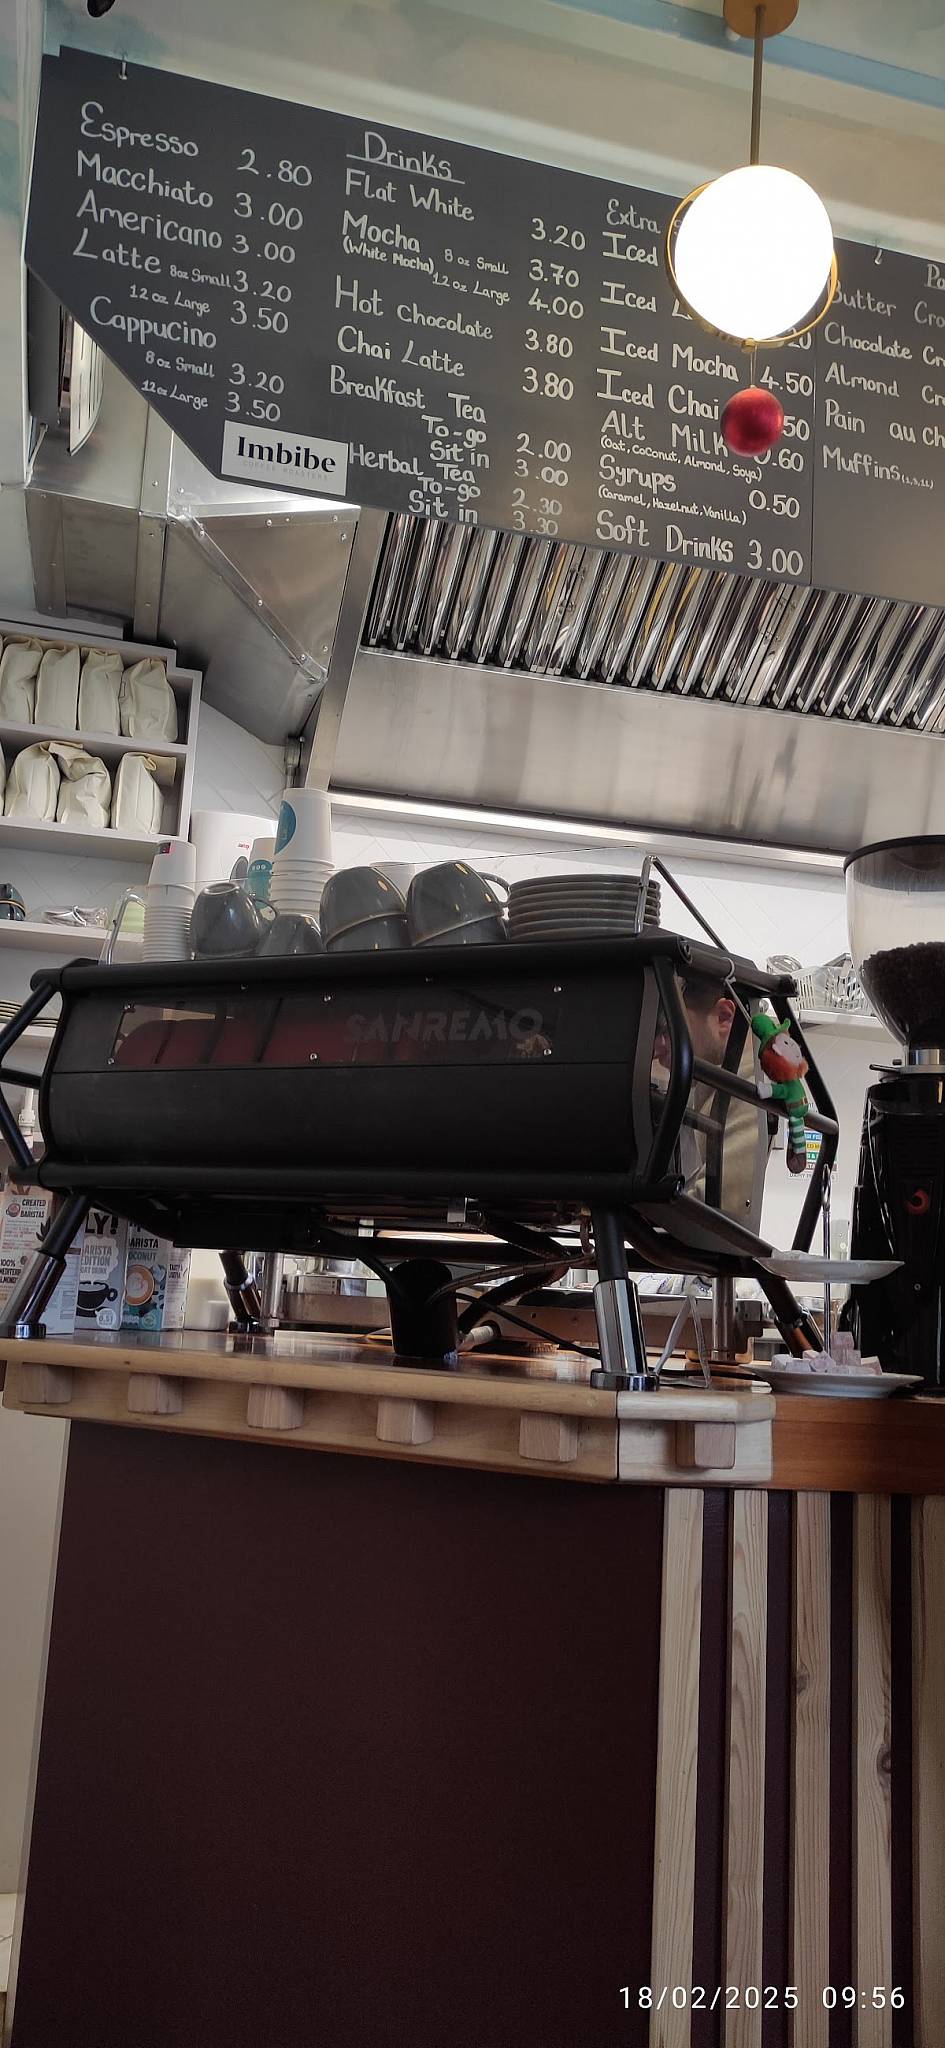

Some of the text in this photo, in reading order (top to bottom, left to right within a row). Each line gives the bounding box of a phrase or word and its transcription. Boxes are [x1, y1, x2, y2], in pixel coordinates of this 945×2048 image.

[81, 101, 312, 186] Espresso 2.80
[364, 131, 453, 179] Drinks
[77, 150, 303, 230] Macchiato 3.00
[346, 168, 586, 251] Flat White 3.20
[76, 189, 296, 264] Americano 3.00
[606, 199, 661, 234] Extra
[73, 228, 161, 274] Latte
[192, 269, 231, 288] Small
[233, 270, 292, 302] 3.20
[342, 210, 420, 253] Mocha
[477, 257, 509, 274] Small
[528, 259, 579, 288] 3.70
[602, 231, 658, 266] Iced
[343, 235, 387, 261] (White
[392, 251, 434, 275] Mocha)
[473, 281, 510, 305] Large
[528, 288, 584, 319] 4.00
[600, 281, 657, 313] Iced
[828, 276, 897, 317] Butter
[90, 296, 217, 348] Cappucino
[175, 291, 210, 317] Large
[230, 301, 289, 333] 3.50
[336, 275, 384, 316] Hot
[525, 328, 573, 358] 3.80
[337, 325, 574, 400] Chai Latte 3.80
[600, 326, 813, 397] Iced Mocha 4.50
[824, 321, 913, 360] Chocolate
[176, 357, 215, 377] Small
[229, 363, 285, 394] 3.20
[330, 364, 486, 424] Breakfast Tea
[824, 362, 900, 398] Almond
[170, 385, 208, 409] Large
[225, 392, 281, 422] 3.50
[596, 368, 810, 441] Iced Chai 50
[601, 410, 645, 441] Alt
[825, 398, 866, 434] Pain
[890, 422, 916, 443] au
[237, 436, 336, 473] Imbibe
[350, 442, 476, 484] Herbal Tea
[430, 440, 569, 487] Sit in 3.00
[516, 432, 572, 463] 2.00
[823, 444, 901, 481] Muffins
[599, 454, 800, 518] Syrups 0.50
[733, 464, 763, 484] Soya)
[408, 489, 559, 535] Sit in 3.30
[512, 488, 563, 515] 2.30
[596, 510, 804, 576] Soft Drinks 3.00
[345, 1008, 543, 1041] SANREMO
[85, 1212, 119, 1235] LY!
